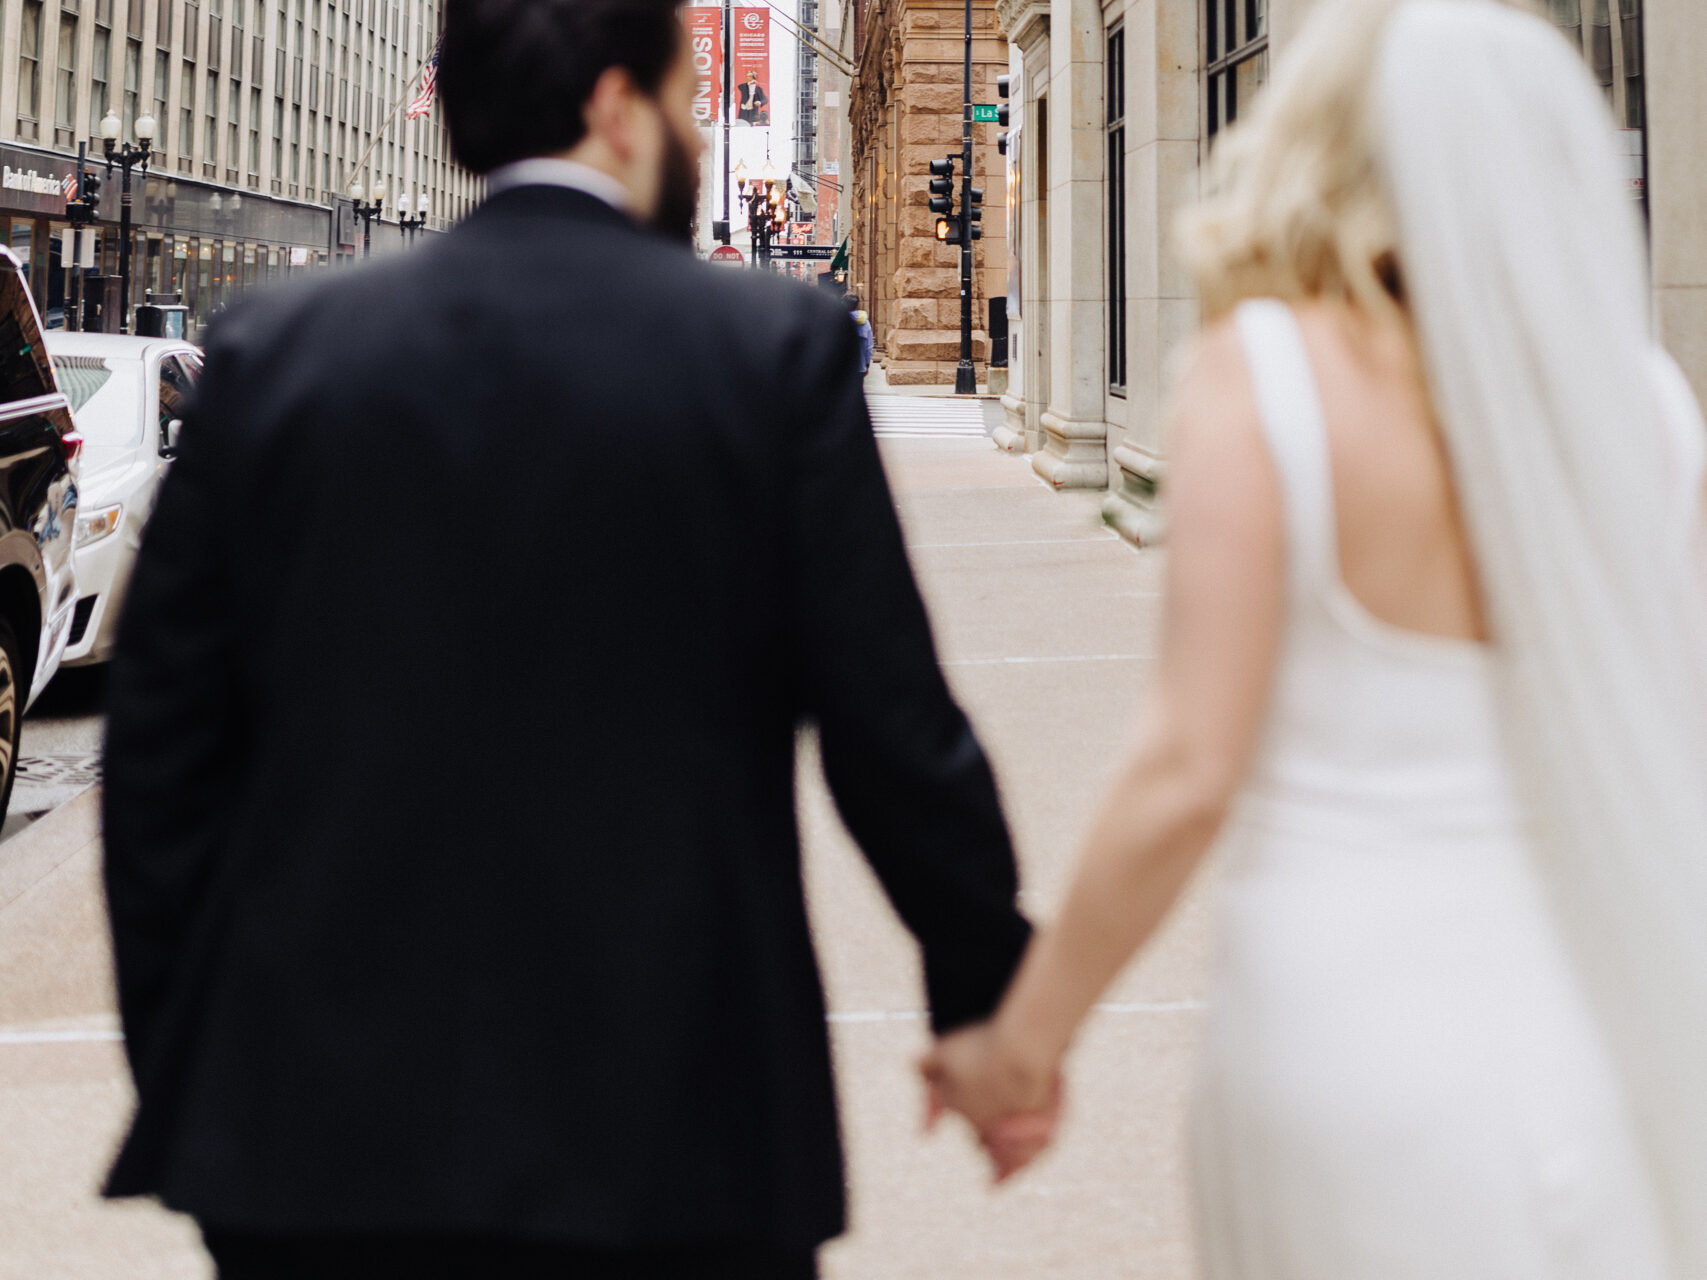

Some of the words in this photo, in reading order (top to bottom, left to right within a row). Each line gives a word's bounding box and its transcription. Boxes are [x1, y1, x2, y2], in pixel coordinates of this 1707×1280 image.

[692, 36, 713, 120] SOUND
[981, 108, 993, 118] La
[713, 252, 723, 260] DO
[725, 252, 740, 260] NOT
